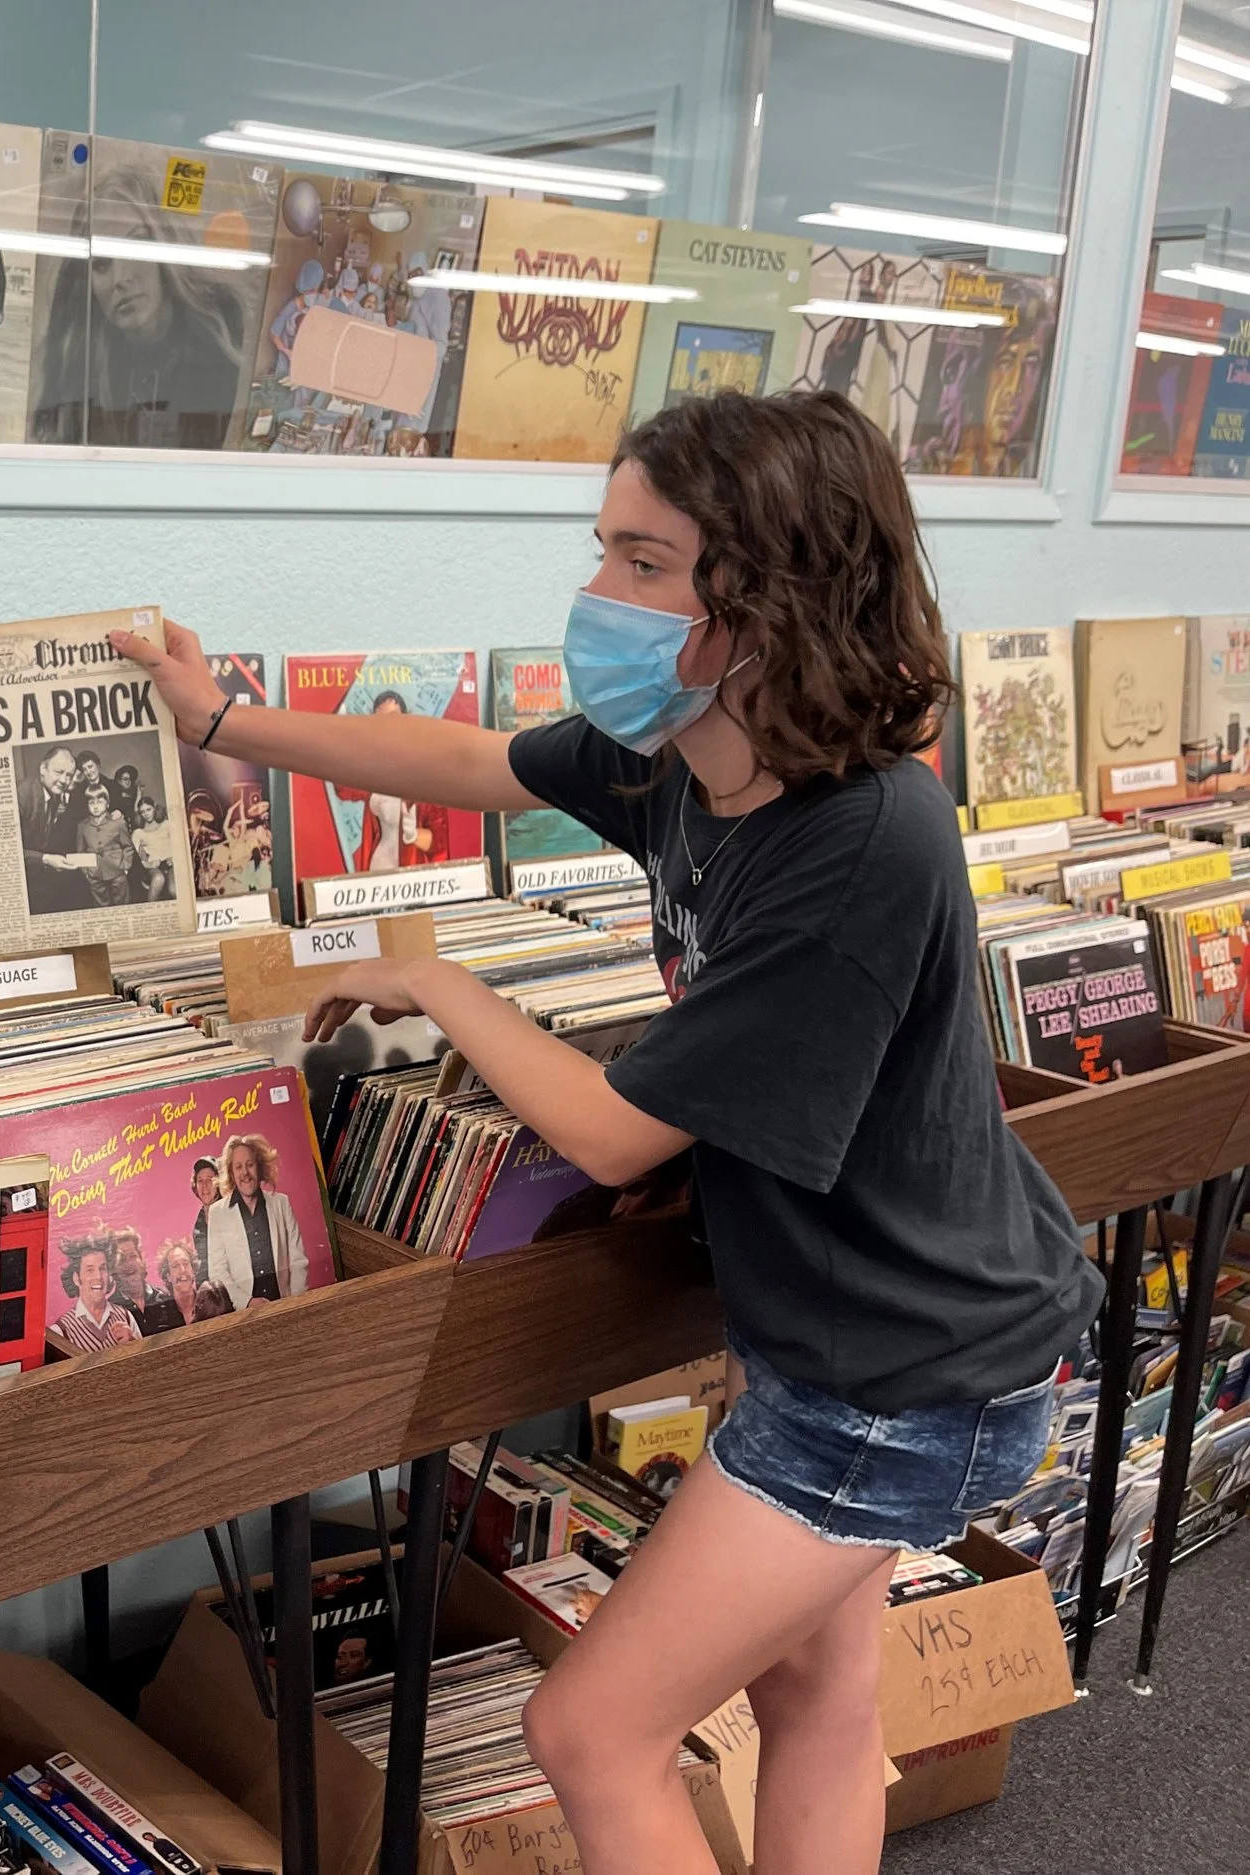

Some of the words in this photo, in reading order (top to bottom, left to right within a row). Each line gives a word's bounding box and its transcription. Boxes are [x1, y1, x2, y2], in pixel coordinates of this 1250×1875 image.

[689, 238, 722, 264] CAT
[724, 243, 786, 273] STEVENS
[297, 666, 350, 688] BLUE
[355, 665, 412, 686] STARR
[513, 663, 562, 690] COMO
[21, 692, 45, 740] A
[53, 679, 159, 736] BRICK
[333, 888, 366, 908] OLD
[517, 871, 546, 889] OLD
[311, 930, 357, 953] ROCK
[1023, 984, 1079, 1016] PEGGY
[1084, 969, 1147, 1002] GEORGE
[1038, 1011, 1073, 1039] LEE
[1077, 991, 1158, 1030] SHEARING
[72, 1137, 118, 1178] Cornell
[121, 1112, 159, 1145] Hurd
[161, 1091, 197, 1123] Band
[108, 1142, 156, 1187] That
[158, 1112, 223, 1159] Unholy
[636, 1426, 694, 1448] Maytime
[900, 1607, 974, 1663] VHS
[920, 1657, 974, 1719] 25¢
[984, 1646, 1044, 1689] EACH
[91, 1787, 143, 1828] DOUBTFIRE
[45, 1839, 67, 1859] EYES
